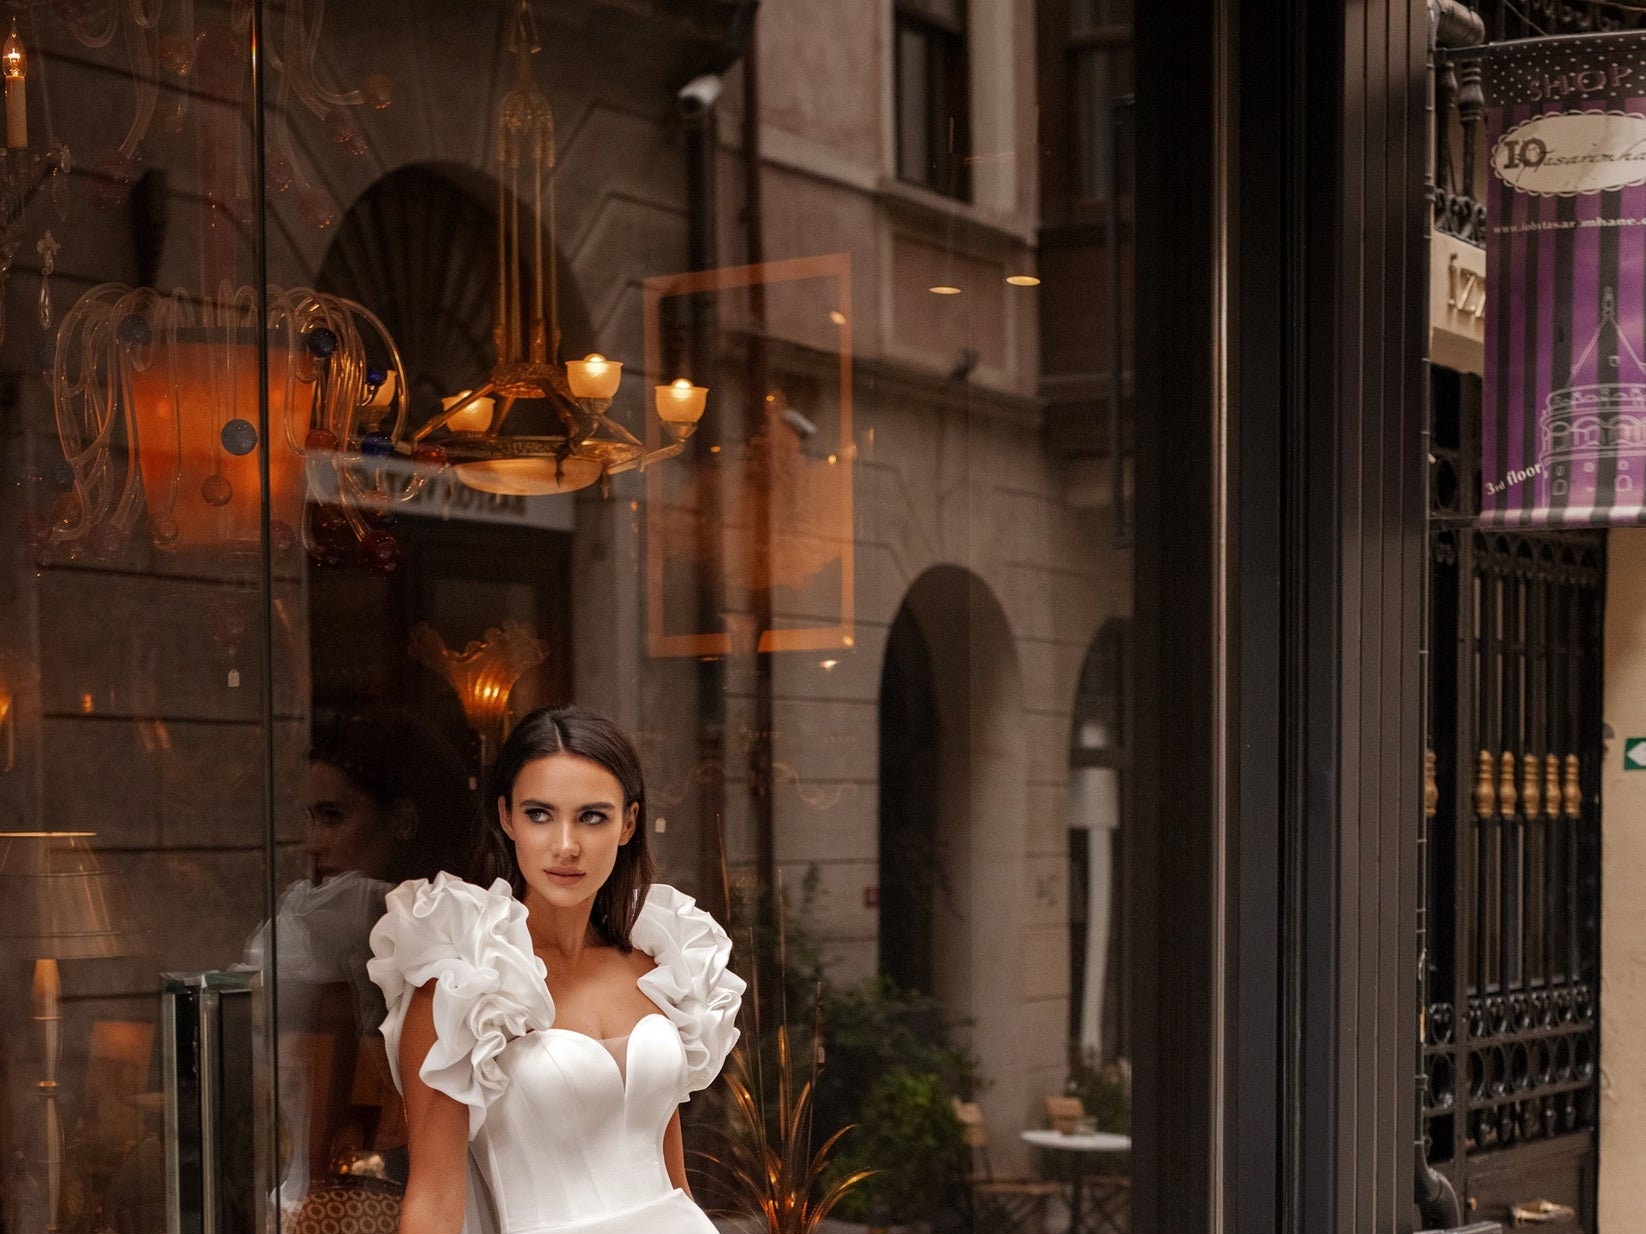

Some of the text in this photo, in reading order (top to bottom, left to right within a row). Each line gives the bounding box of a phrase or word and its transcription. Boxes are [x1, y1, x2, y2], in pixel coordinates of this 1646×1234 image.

[1529, 65, 1633, 101] SHOP
[1485, 462, 1542, 496] 3rd floor
